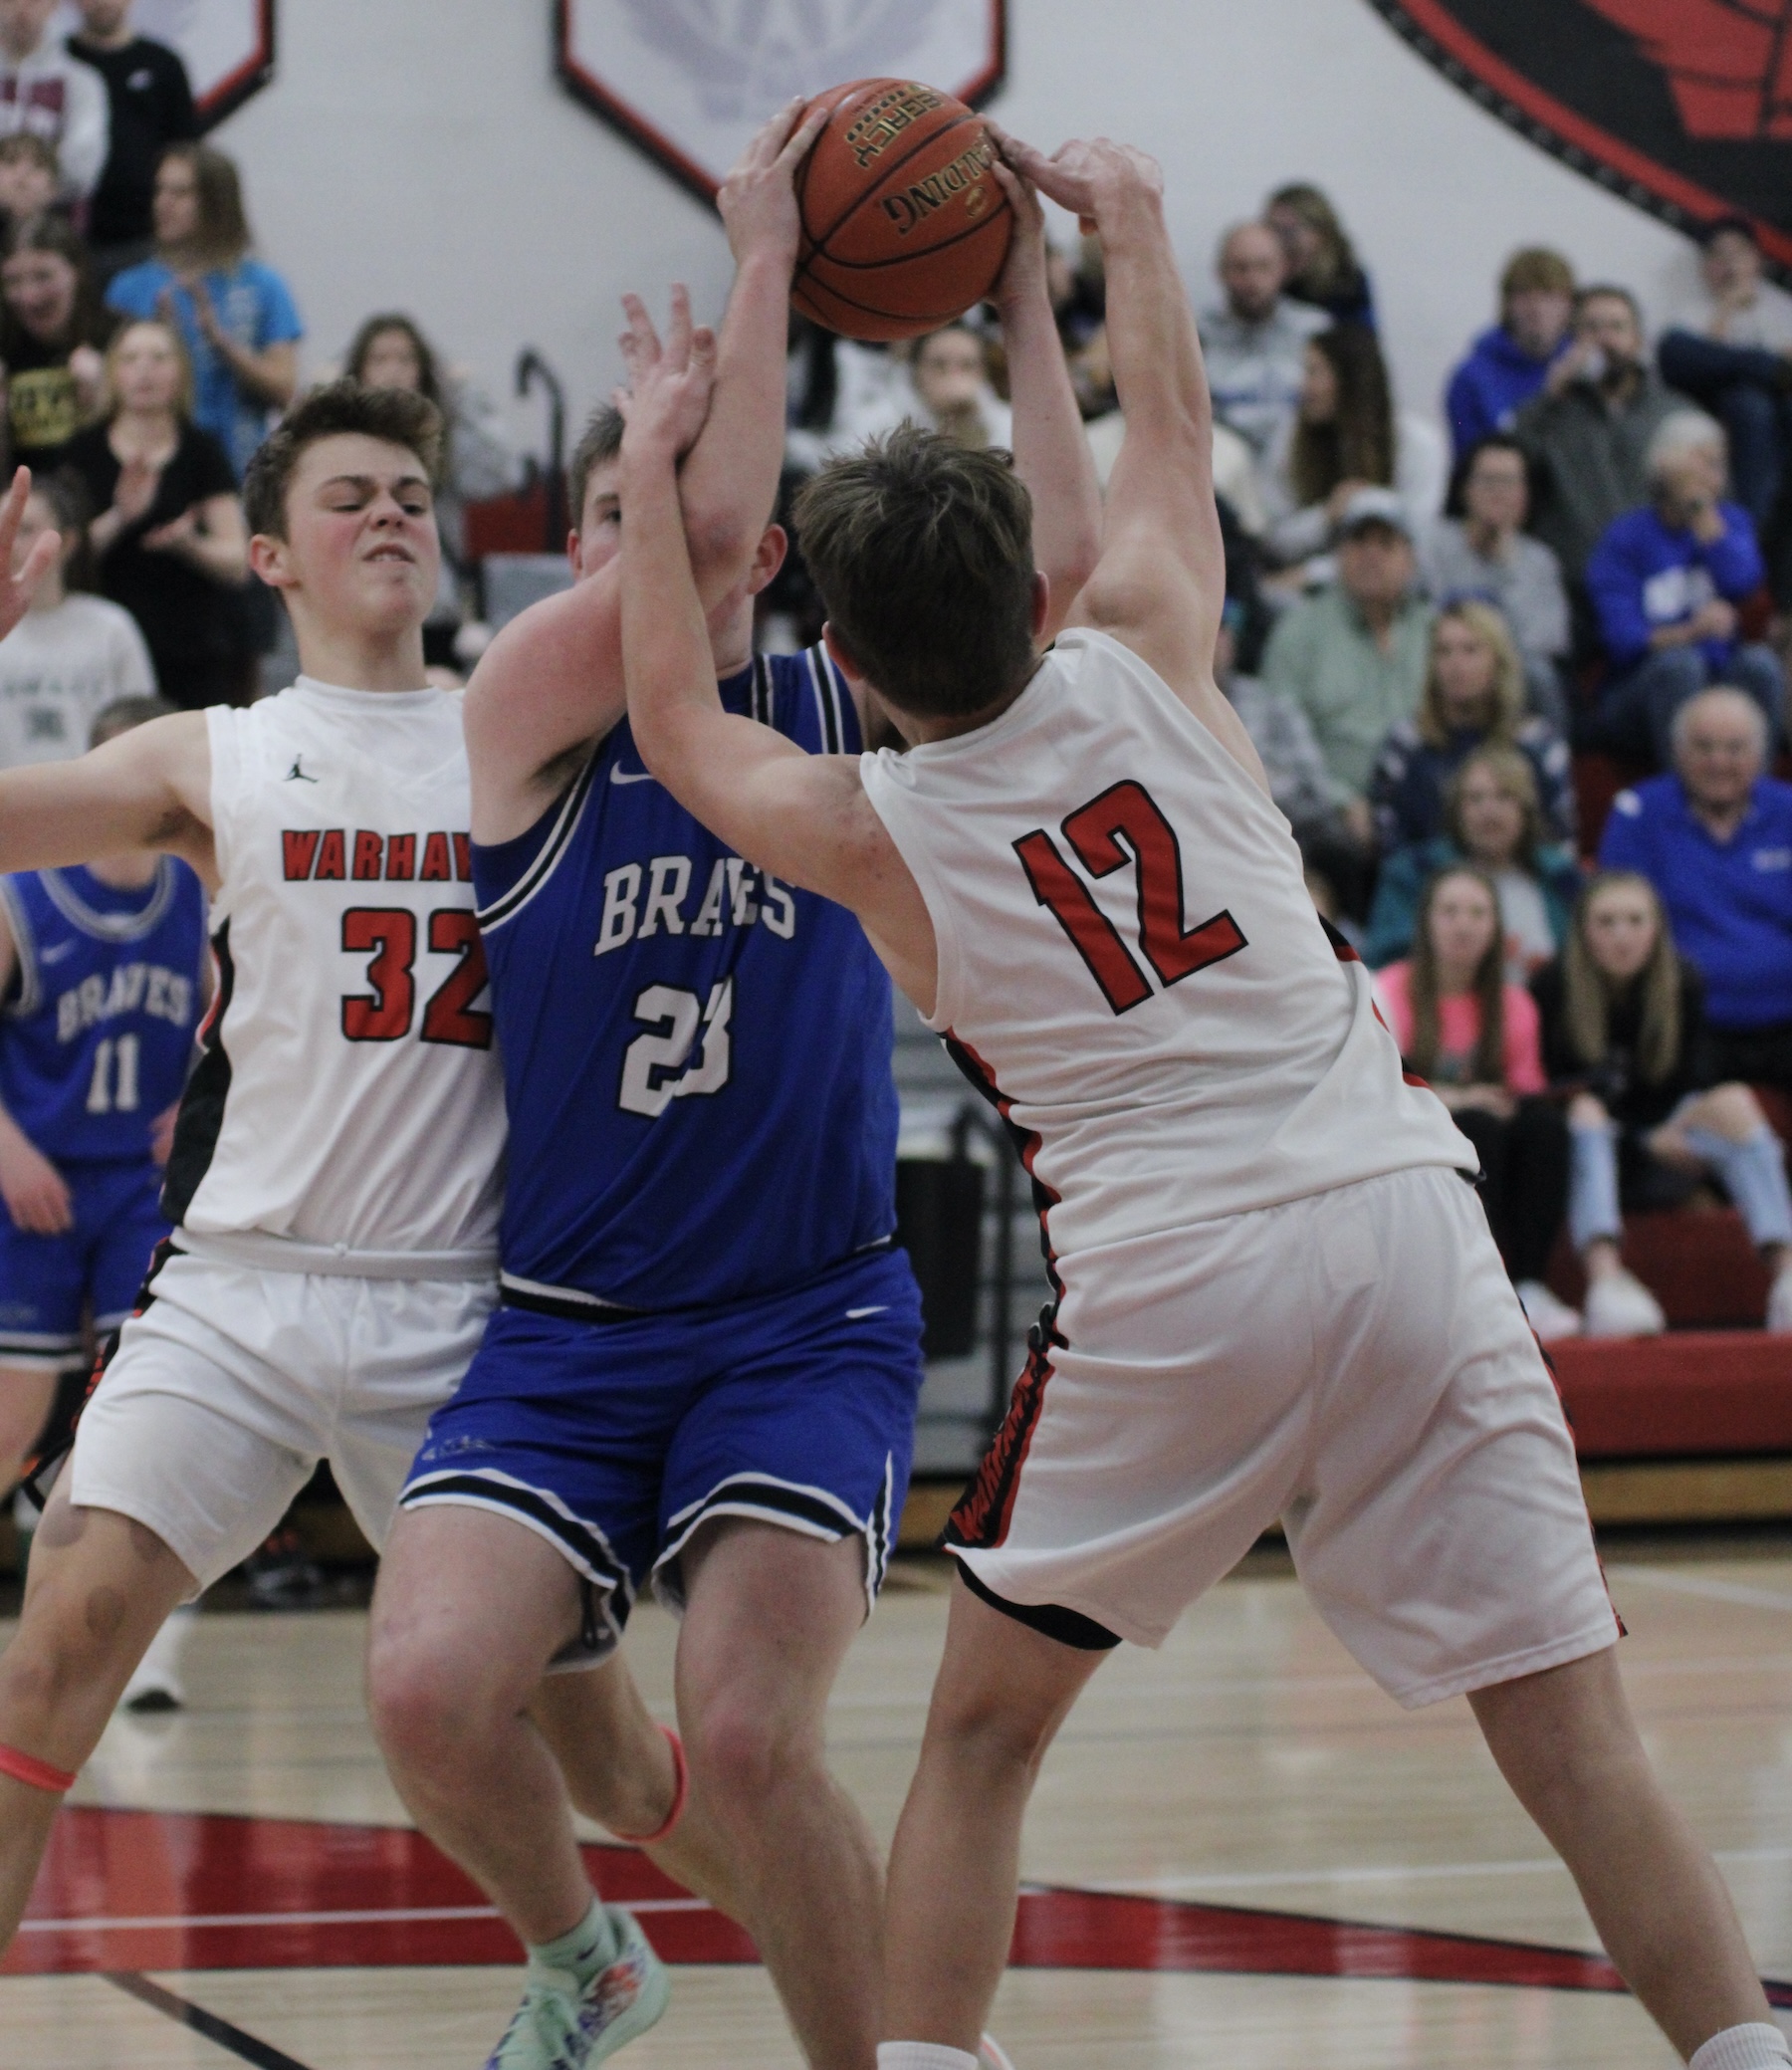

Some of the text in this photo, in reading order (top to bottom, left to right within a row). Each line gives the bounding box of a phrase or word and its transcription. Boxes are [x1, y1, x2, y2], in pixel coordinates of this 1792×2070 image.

[853, 92, 944, 169] EGACY
[881, 148, 992, 234] ALDING
[1011, 780, 1248, 1016] 12
[57, 963, 190, 1041] BRAVES
[341, 907, 493, 1050] 32
[86, 1034, 138, 1113] 11
[619, 975, 734, 1118] 23
